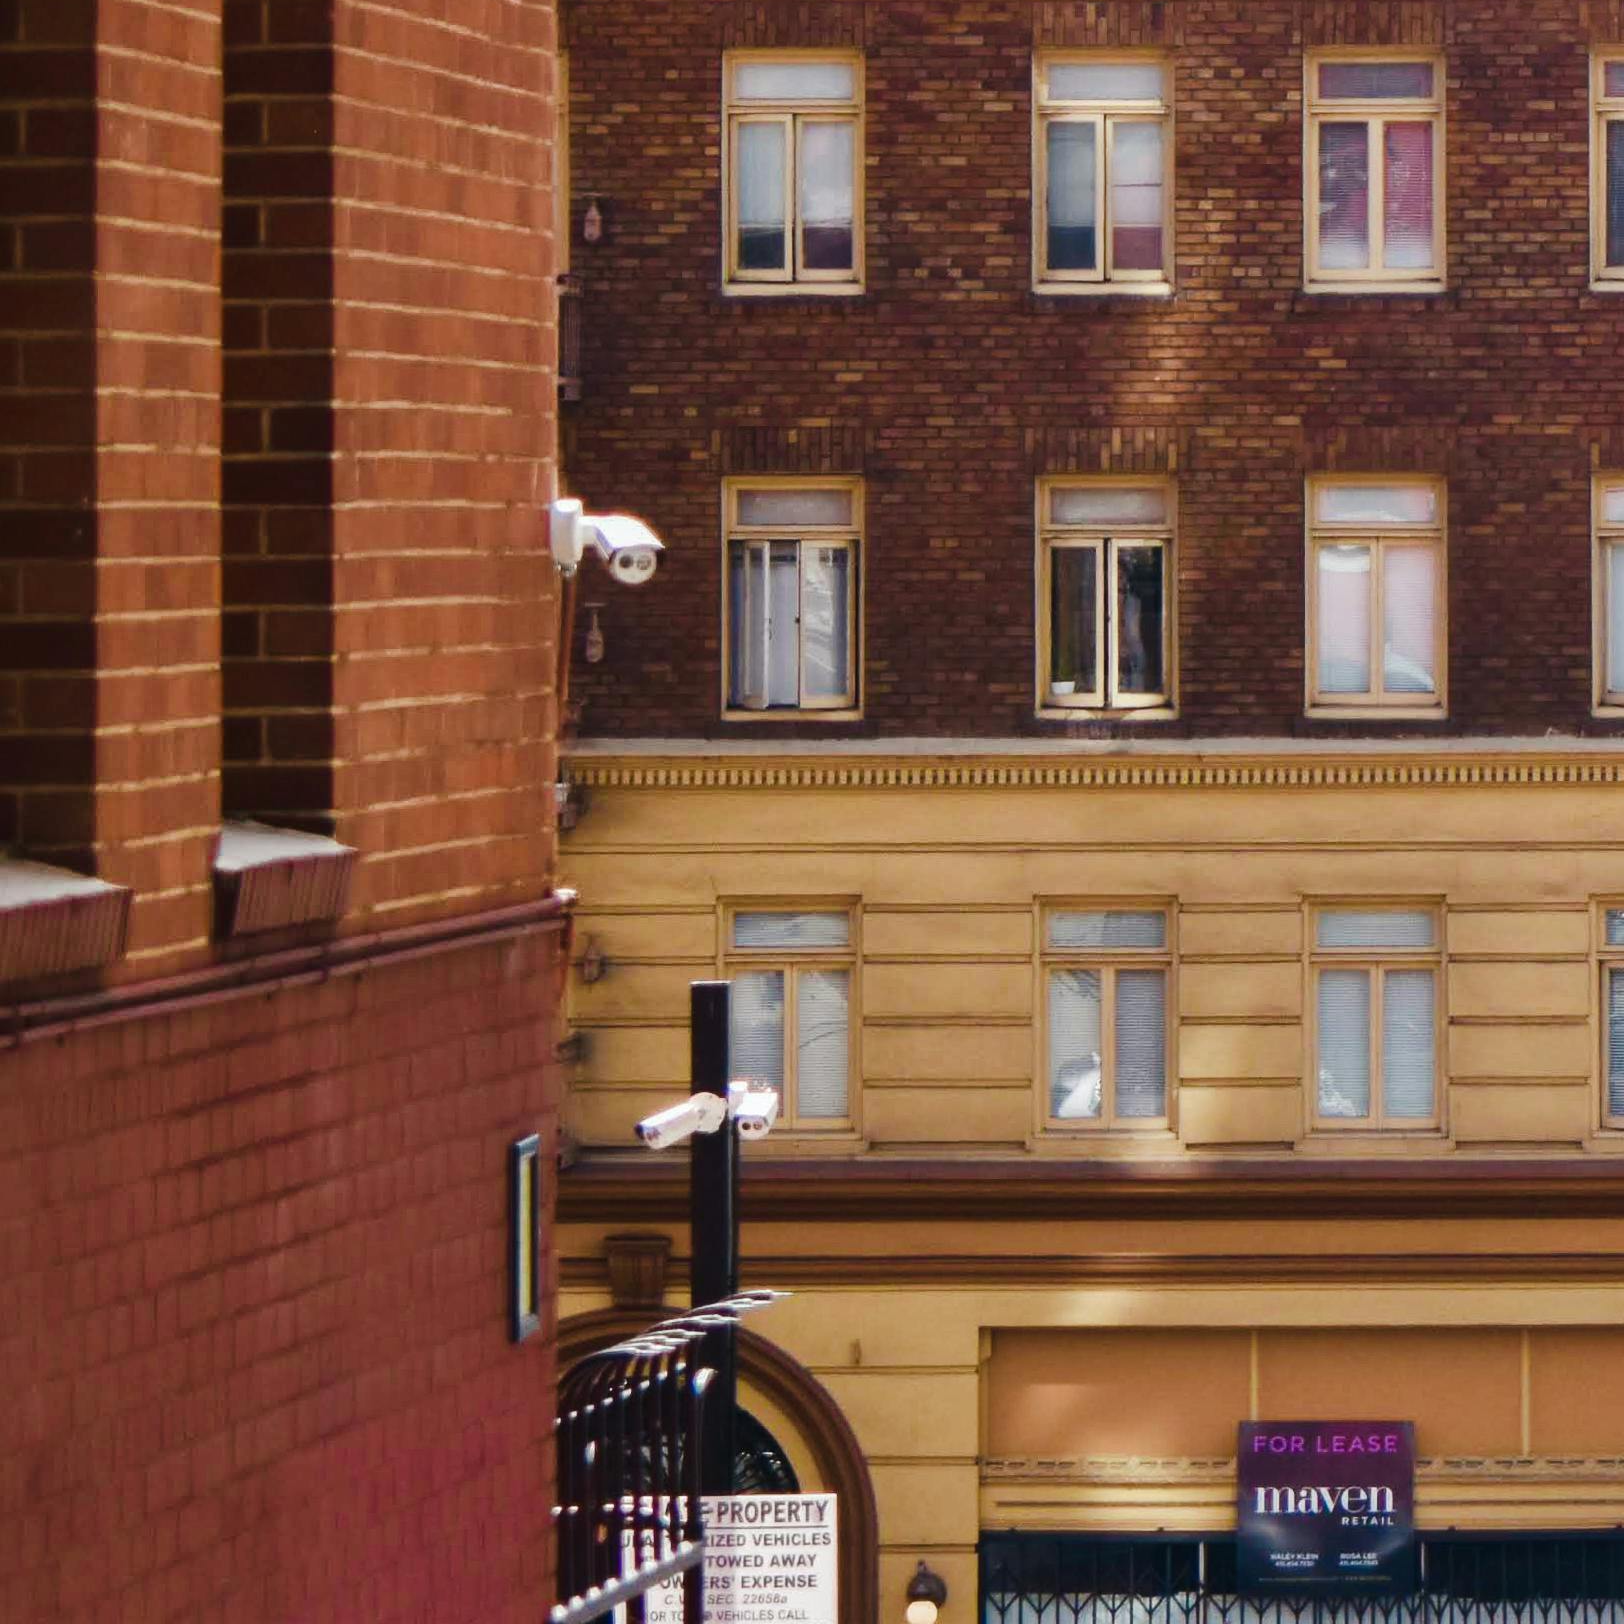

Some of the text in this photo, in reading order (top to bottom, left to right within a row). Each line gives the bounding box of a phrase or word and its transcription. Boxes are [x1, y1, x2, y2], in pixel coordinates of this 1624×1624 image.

[1253, 1435, 1398, 1453] FOR LEASE
[1254, 1486, 1396, 1514] maven
[717, 1500, 829, 1523] PROPERTY
[1341, 1516, 1394, 1526] RETAIL
[752, 1532, 832, 1546] VEHICLES
[706, 1554, 817, 1568] TOWED AWAY
[741, 1575, 818, 1588] EXPENSE
[717, 1610, 774, 1622] VEHICLES
[778, 1610, 808, 1621] CALL
